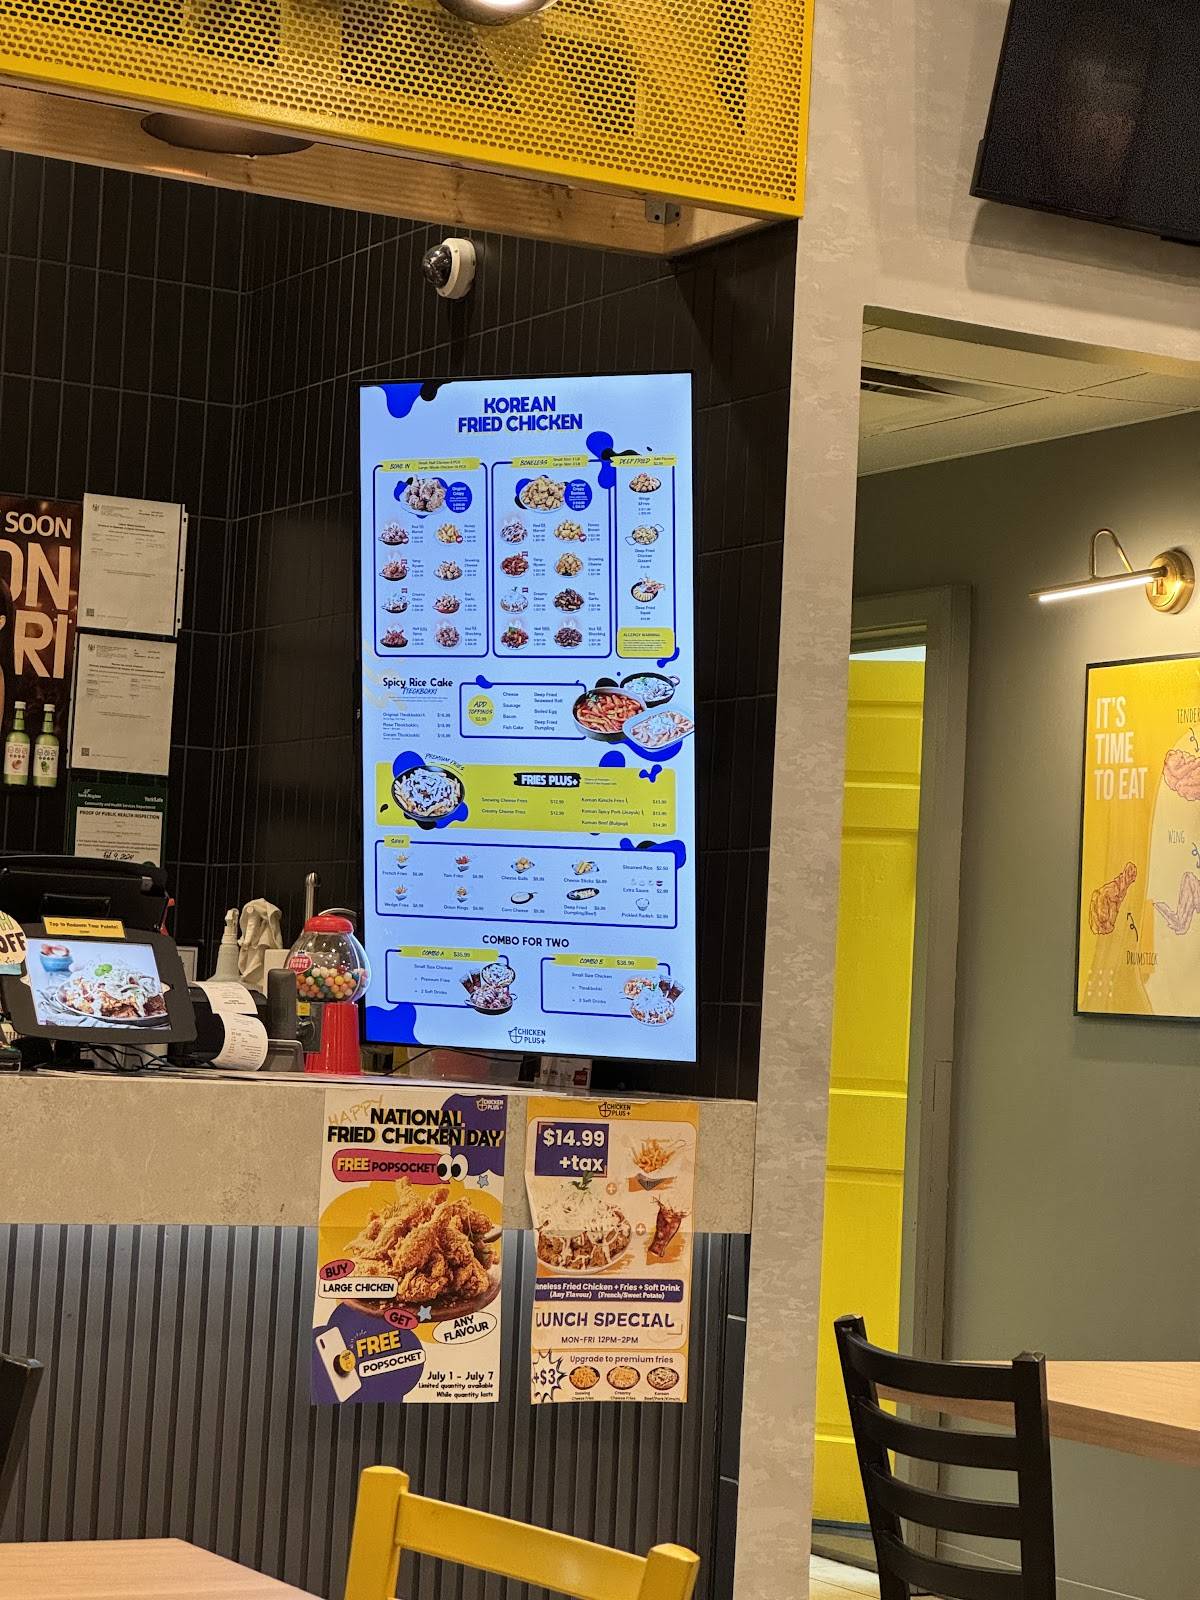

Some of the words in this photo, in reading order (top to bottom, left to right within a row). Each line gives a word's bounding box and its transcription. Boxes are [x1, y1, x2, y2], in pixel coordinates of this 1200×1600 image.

[484, 396, 555, 413] KOREAN
[458, 416, 500, 432] FRIED
[506, 414, 582, 431] CHICKEN
[5, 511, 72, 539] SOON
[383, 678, 406, 688] Spicy
[409, 678, 427, 686] Rice
[430, 678, 453, 686] Cake
[1096, 696, 1126, 728] IT'S
[1096, 732, 1134, 764] TIME
[521, 775, 546, 785] FRIES
[548, 776, 578, 786] PLUS+
[1094, 768, 1114, 800] TO
[1119, 768, 1148, 800] EAT
[1168, 830, 1185, 844] WING
[482, 935, 519, 945] COMBO
[522, 936, 543, 946] FOR
[546, 938, 569, 948] TWO
[518, 1028, 546, 1036] CHICKEN
[328, 1094, 383, 1126] HAPPY
[371, 1108, 462, 1126] NATIONAL
[328, 1126, 376, 1143] FRIED
[382, 1128, 462, 1146] CHICKEN
[467, 1130, 504, 1147] DAY
[543, 1128, 605, 1148] $14.99
[337, 1158, 370, 1172] FREE
[372, 1162, 436, 1173] POPSOCKET
[560, 1154, 604, 1172] +tax
[326, 1264, 348, 1278] BUY
[324, 1284, 352, 1292] LARGE
[356, 1284, 394, 1292] CHICKEN
[390, 1312, 412, 1327] GET
[454, 1314, 474, 1328] ANY
[536, 1312, 588, 1327] LUNCH
[594, 1312, 674, 1328] SPECIAL
[444, 1322, 489, 1342] FLAVOUR
[356, 1330, 401, 1357] FREE
[363, 1352, 422, 1374] POPSOCKET
[570, 1356, 604, 1364] Upgrade
[614, 1356, 654, 1364] premium
[428, 1372, 446, 1382] July
[450, 1372, 453, 1380] 1
[466, 1372, 485, 1382] July
[488, 1372, 494, 1380] 7
[533, 1368, 556, 1385] +$3
